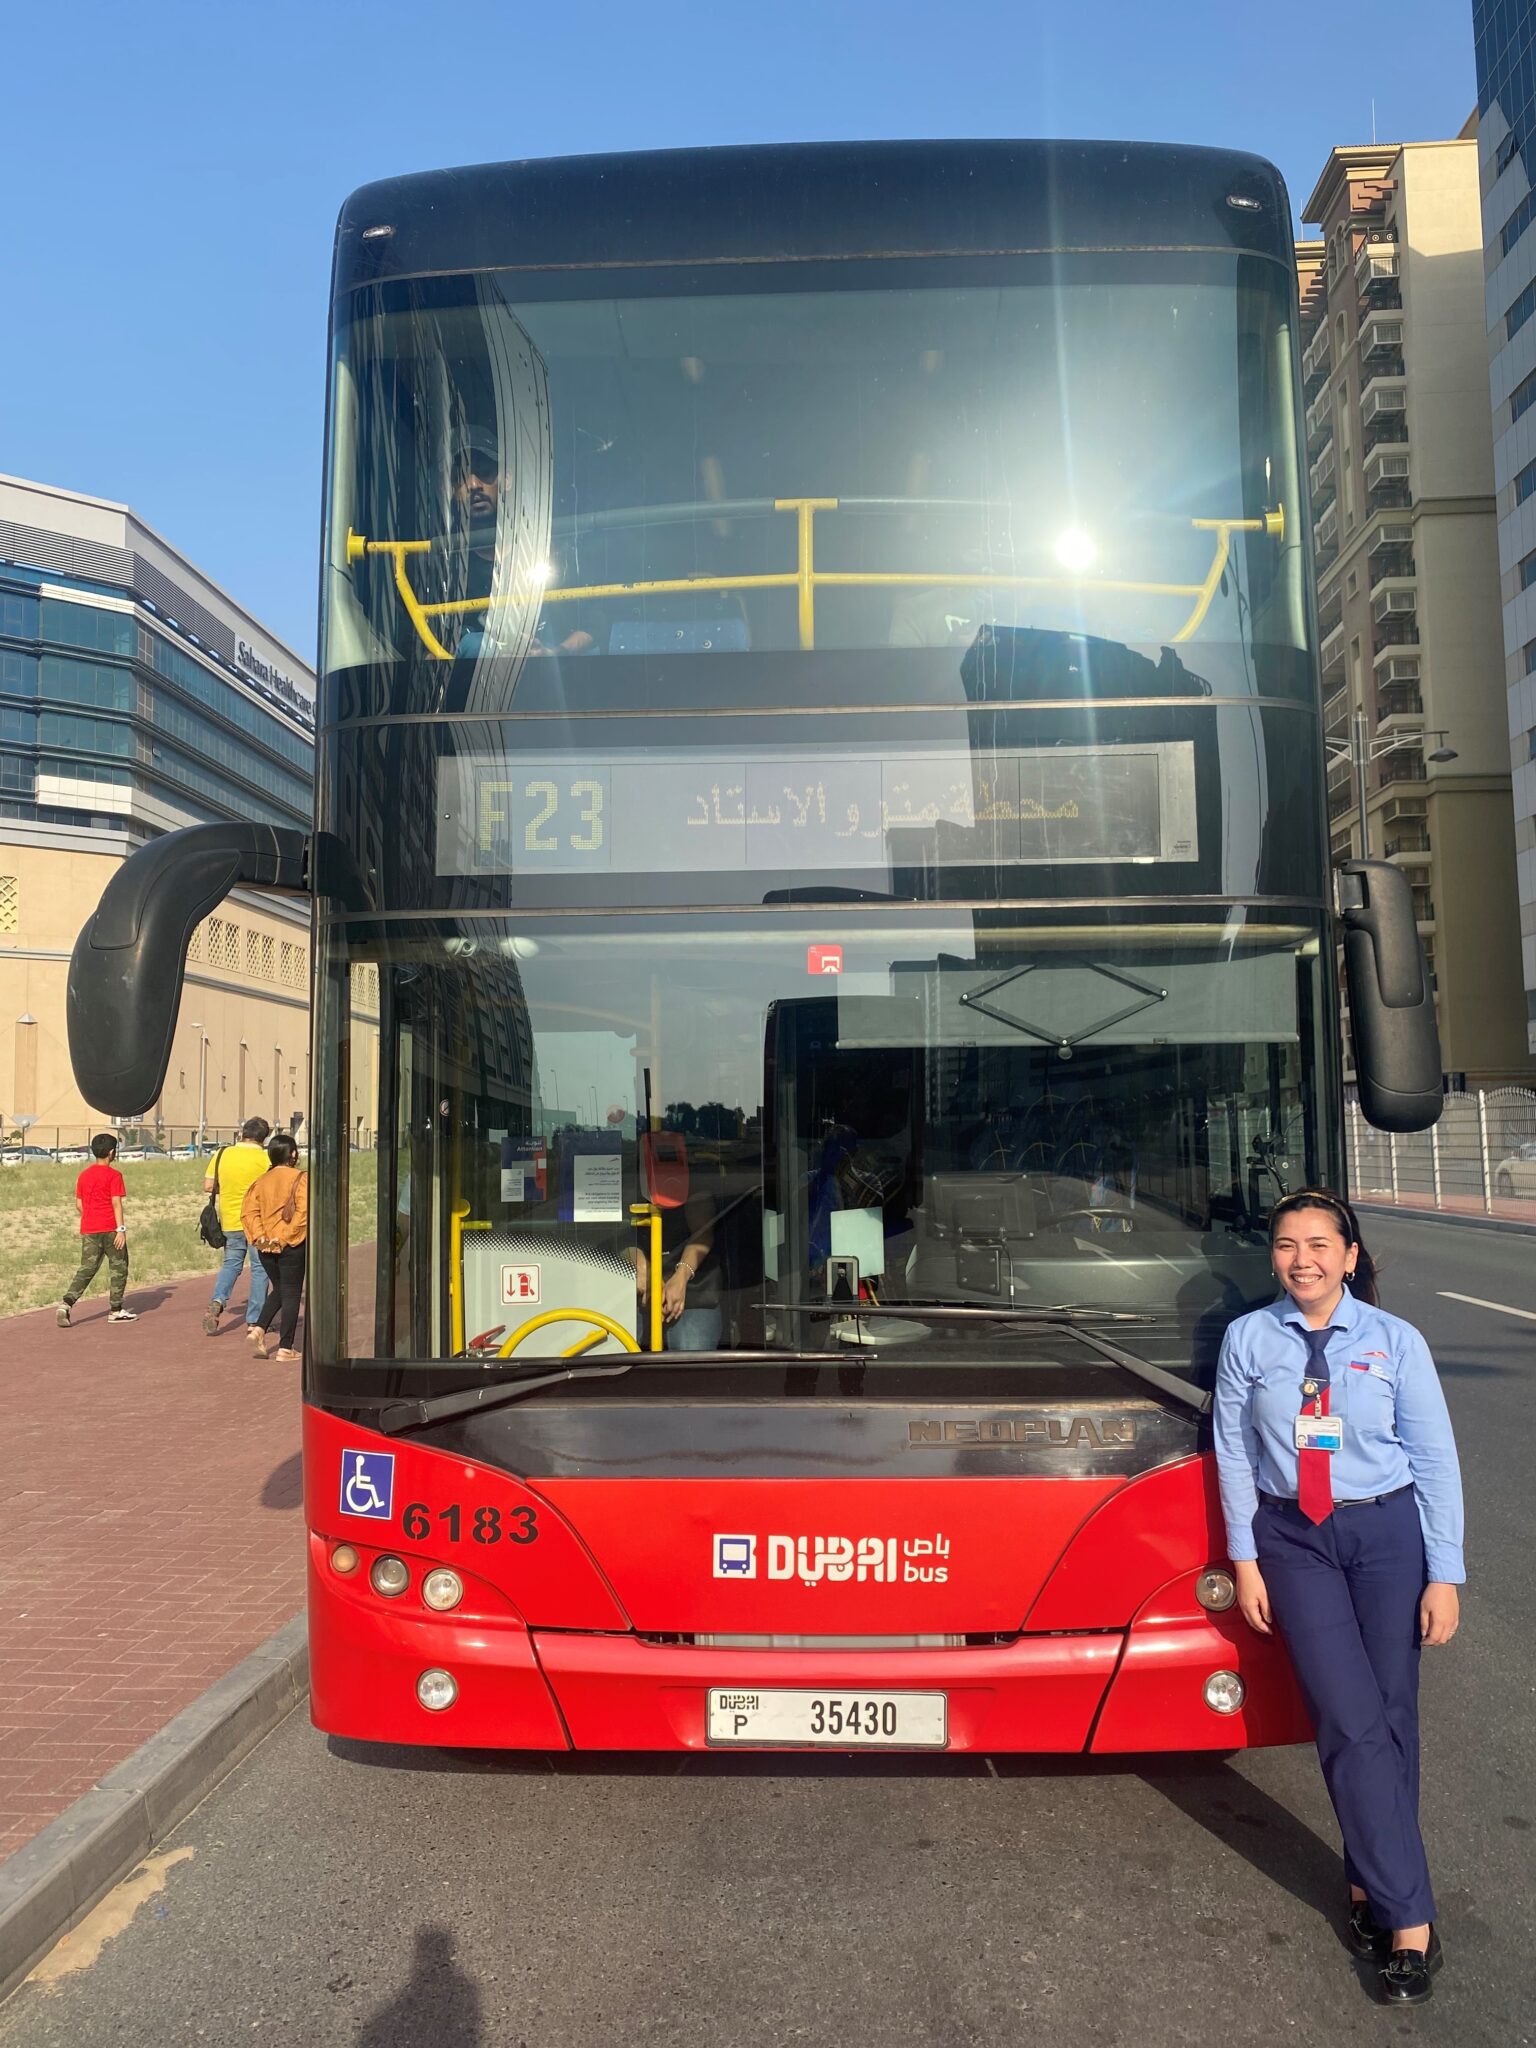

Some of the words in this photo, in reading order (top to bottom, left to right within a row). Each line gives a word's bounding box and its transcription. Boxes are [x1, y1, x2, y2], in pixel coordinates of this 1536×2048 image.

[238, 641, 269, 682] Sahara
[269, 665, 312, 715] Healthcare
[479, 780, 605, 852] F23
[686, 781, 827, 828] الاستاد
[832, 782, 940, 839] مترو
[908, 1417, 1136, 1446] NEOPLAN
[402, 1502, 540, 1544] 6183
[767, 1534, 898, 1586] DUBAI
[903, 1533, 951, 1559] باص
[903, 1561, 949, 1583] bus
[733, 1714, 748, 1735] P
[810, 1699, 898, 1736] 35430
